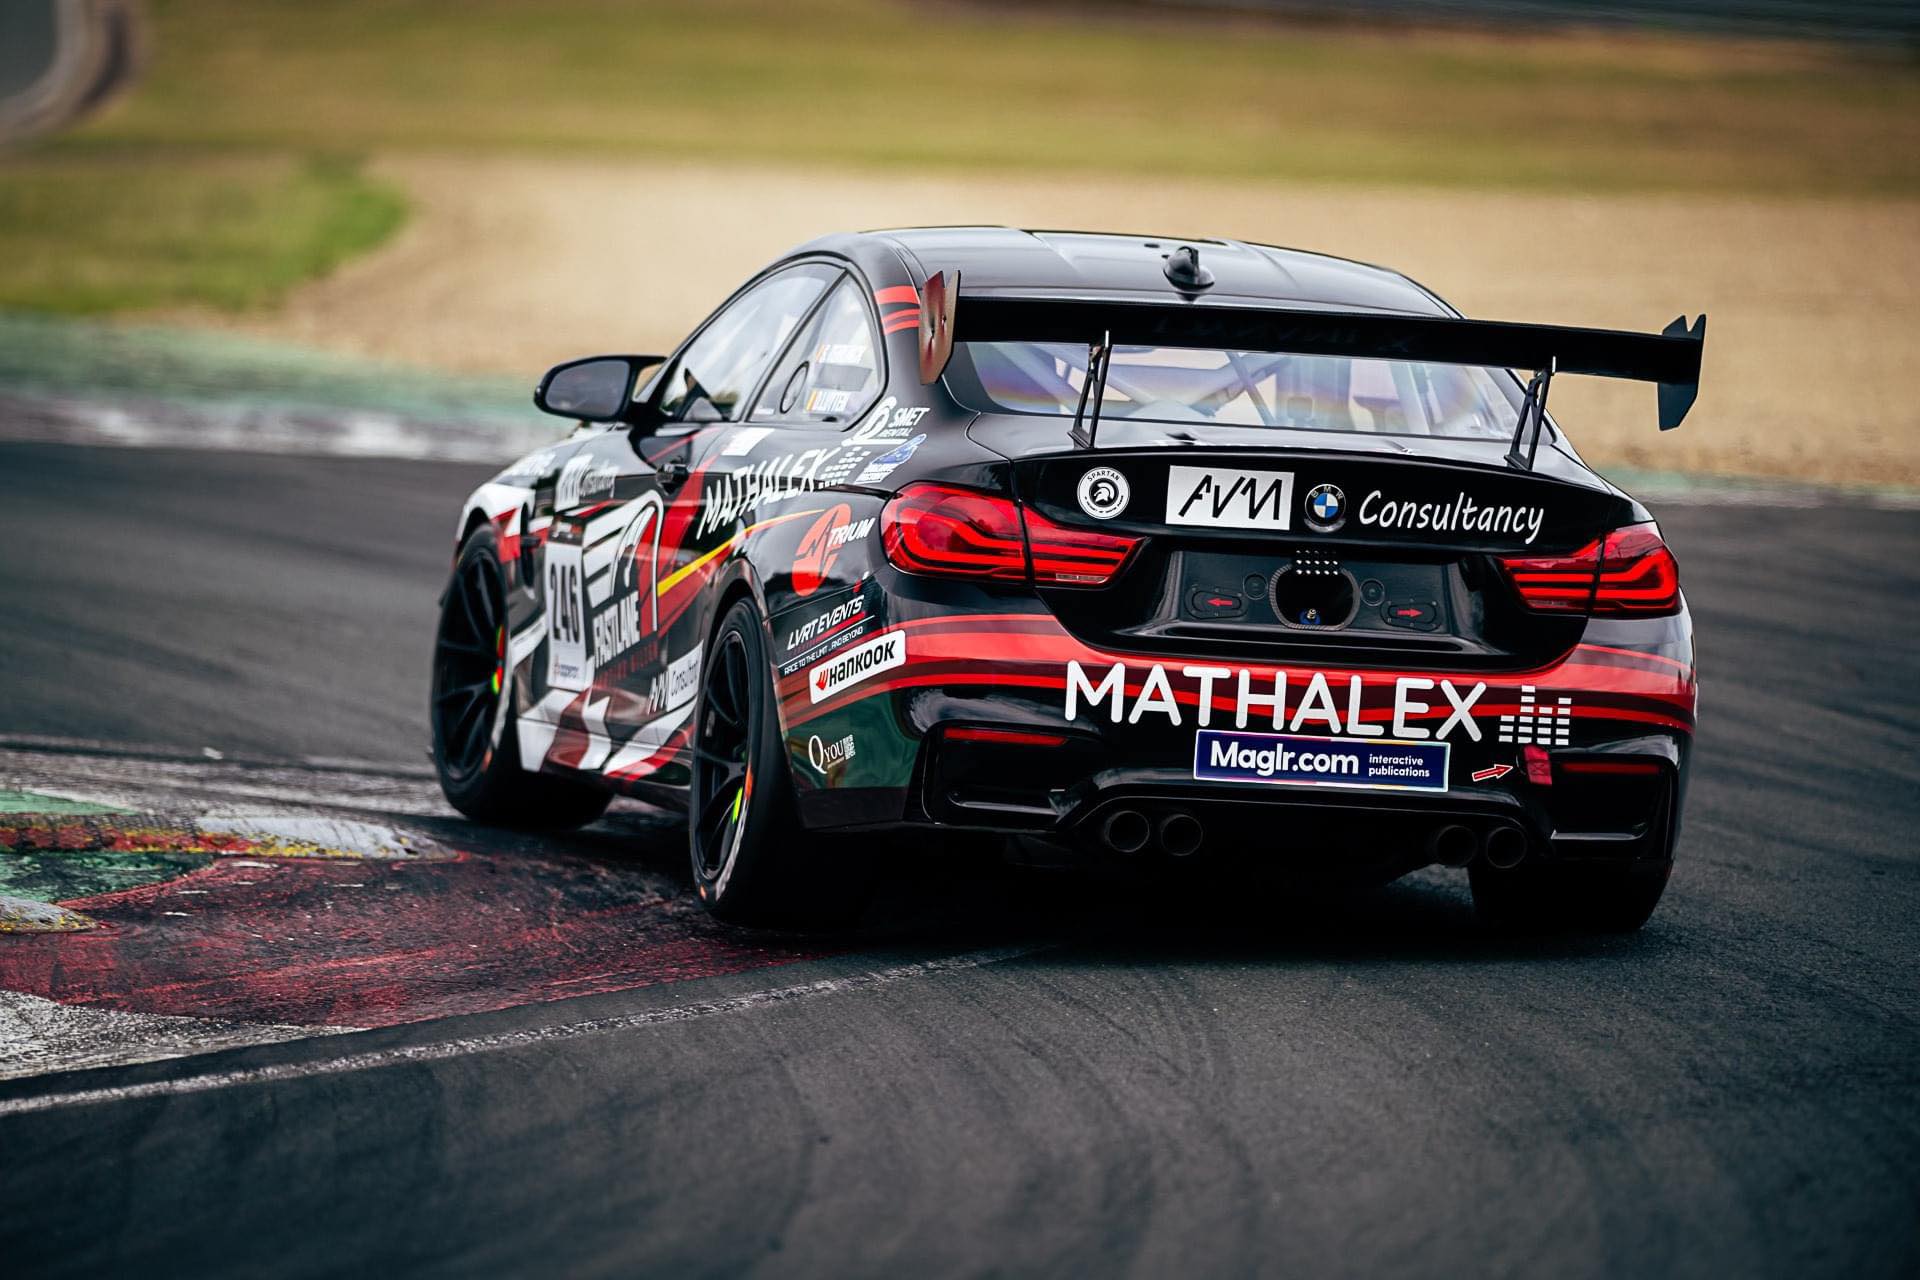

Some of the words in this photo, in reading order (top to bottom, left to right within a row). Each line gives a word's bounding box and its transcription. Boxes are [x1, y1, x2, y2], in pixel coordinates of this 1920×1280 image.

[888, 407, 931, 428] SMET
[696, 446, 843, 540] MATHALEX
[1087, 470, 1120, 481] SPARTAN
[1178, 474, 1282, 521] AVM
[1358, 490, 1544, 545] Consultancy
[550, 563, 580, 644] 246
[786, 618, 819, 651] LVRT
[817, 594, 865, 634] EVENTS
[592, 590, 641, 670] FASTLANE
[783, 661, 799, 676] RACE
[799, 658, 806, 669] TO
[805, 653, 816, 666] THE
[842, 626, 864, 645] BEYOND
[1064, 659, 1487, 742] MATHALEX
[1209, 740, 1360, 777] Maglr.com
[1368, 753, 1424, 766] interactive
[1368, 765, 1430, 777] publications
